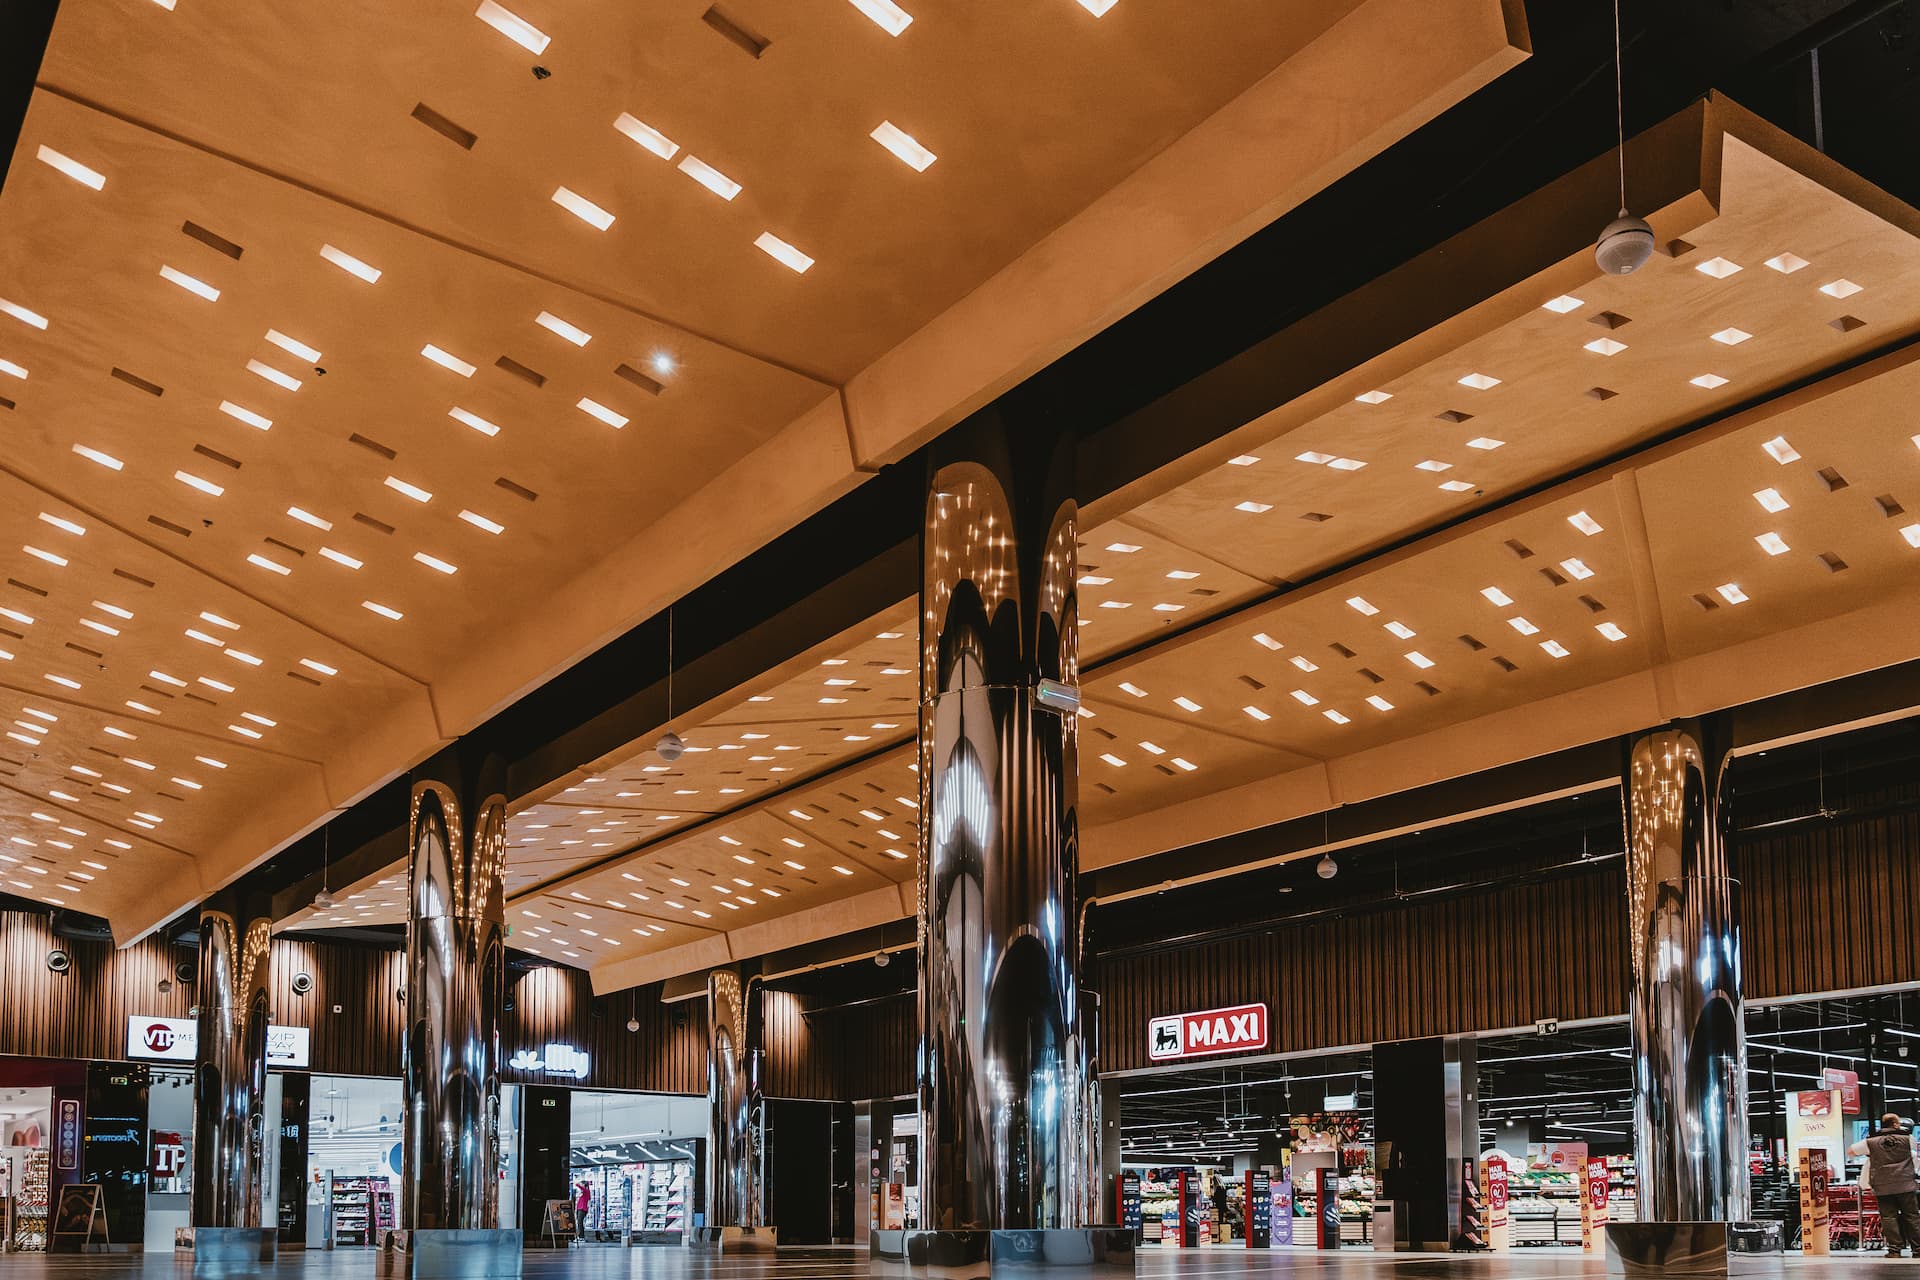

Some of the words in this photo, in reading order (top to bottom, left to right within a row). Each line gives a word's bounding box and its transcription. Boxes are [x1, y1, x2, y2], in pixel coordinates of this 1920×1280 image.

[144, 1029, 175, 1048] VIP
[1188, 1012, 1259, 1047] MAXI
[155, 1144, 187, 1171] IP
